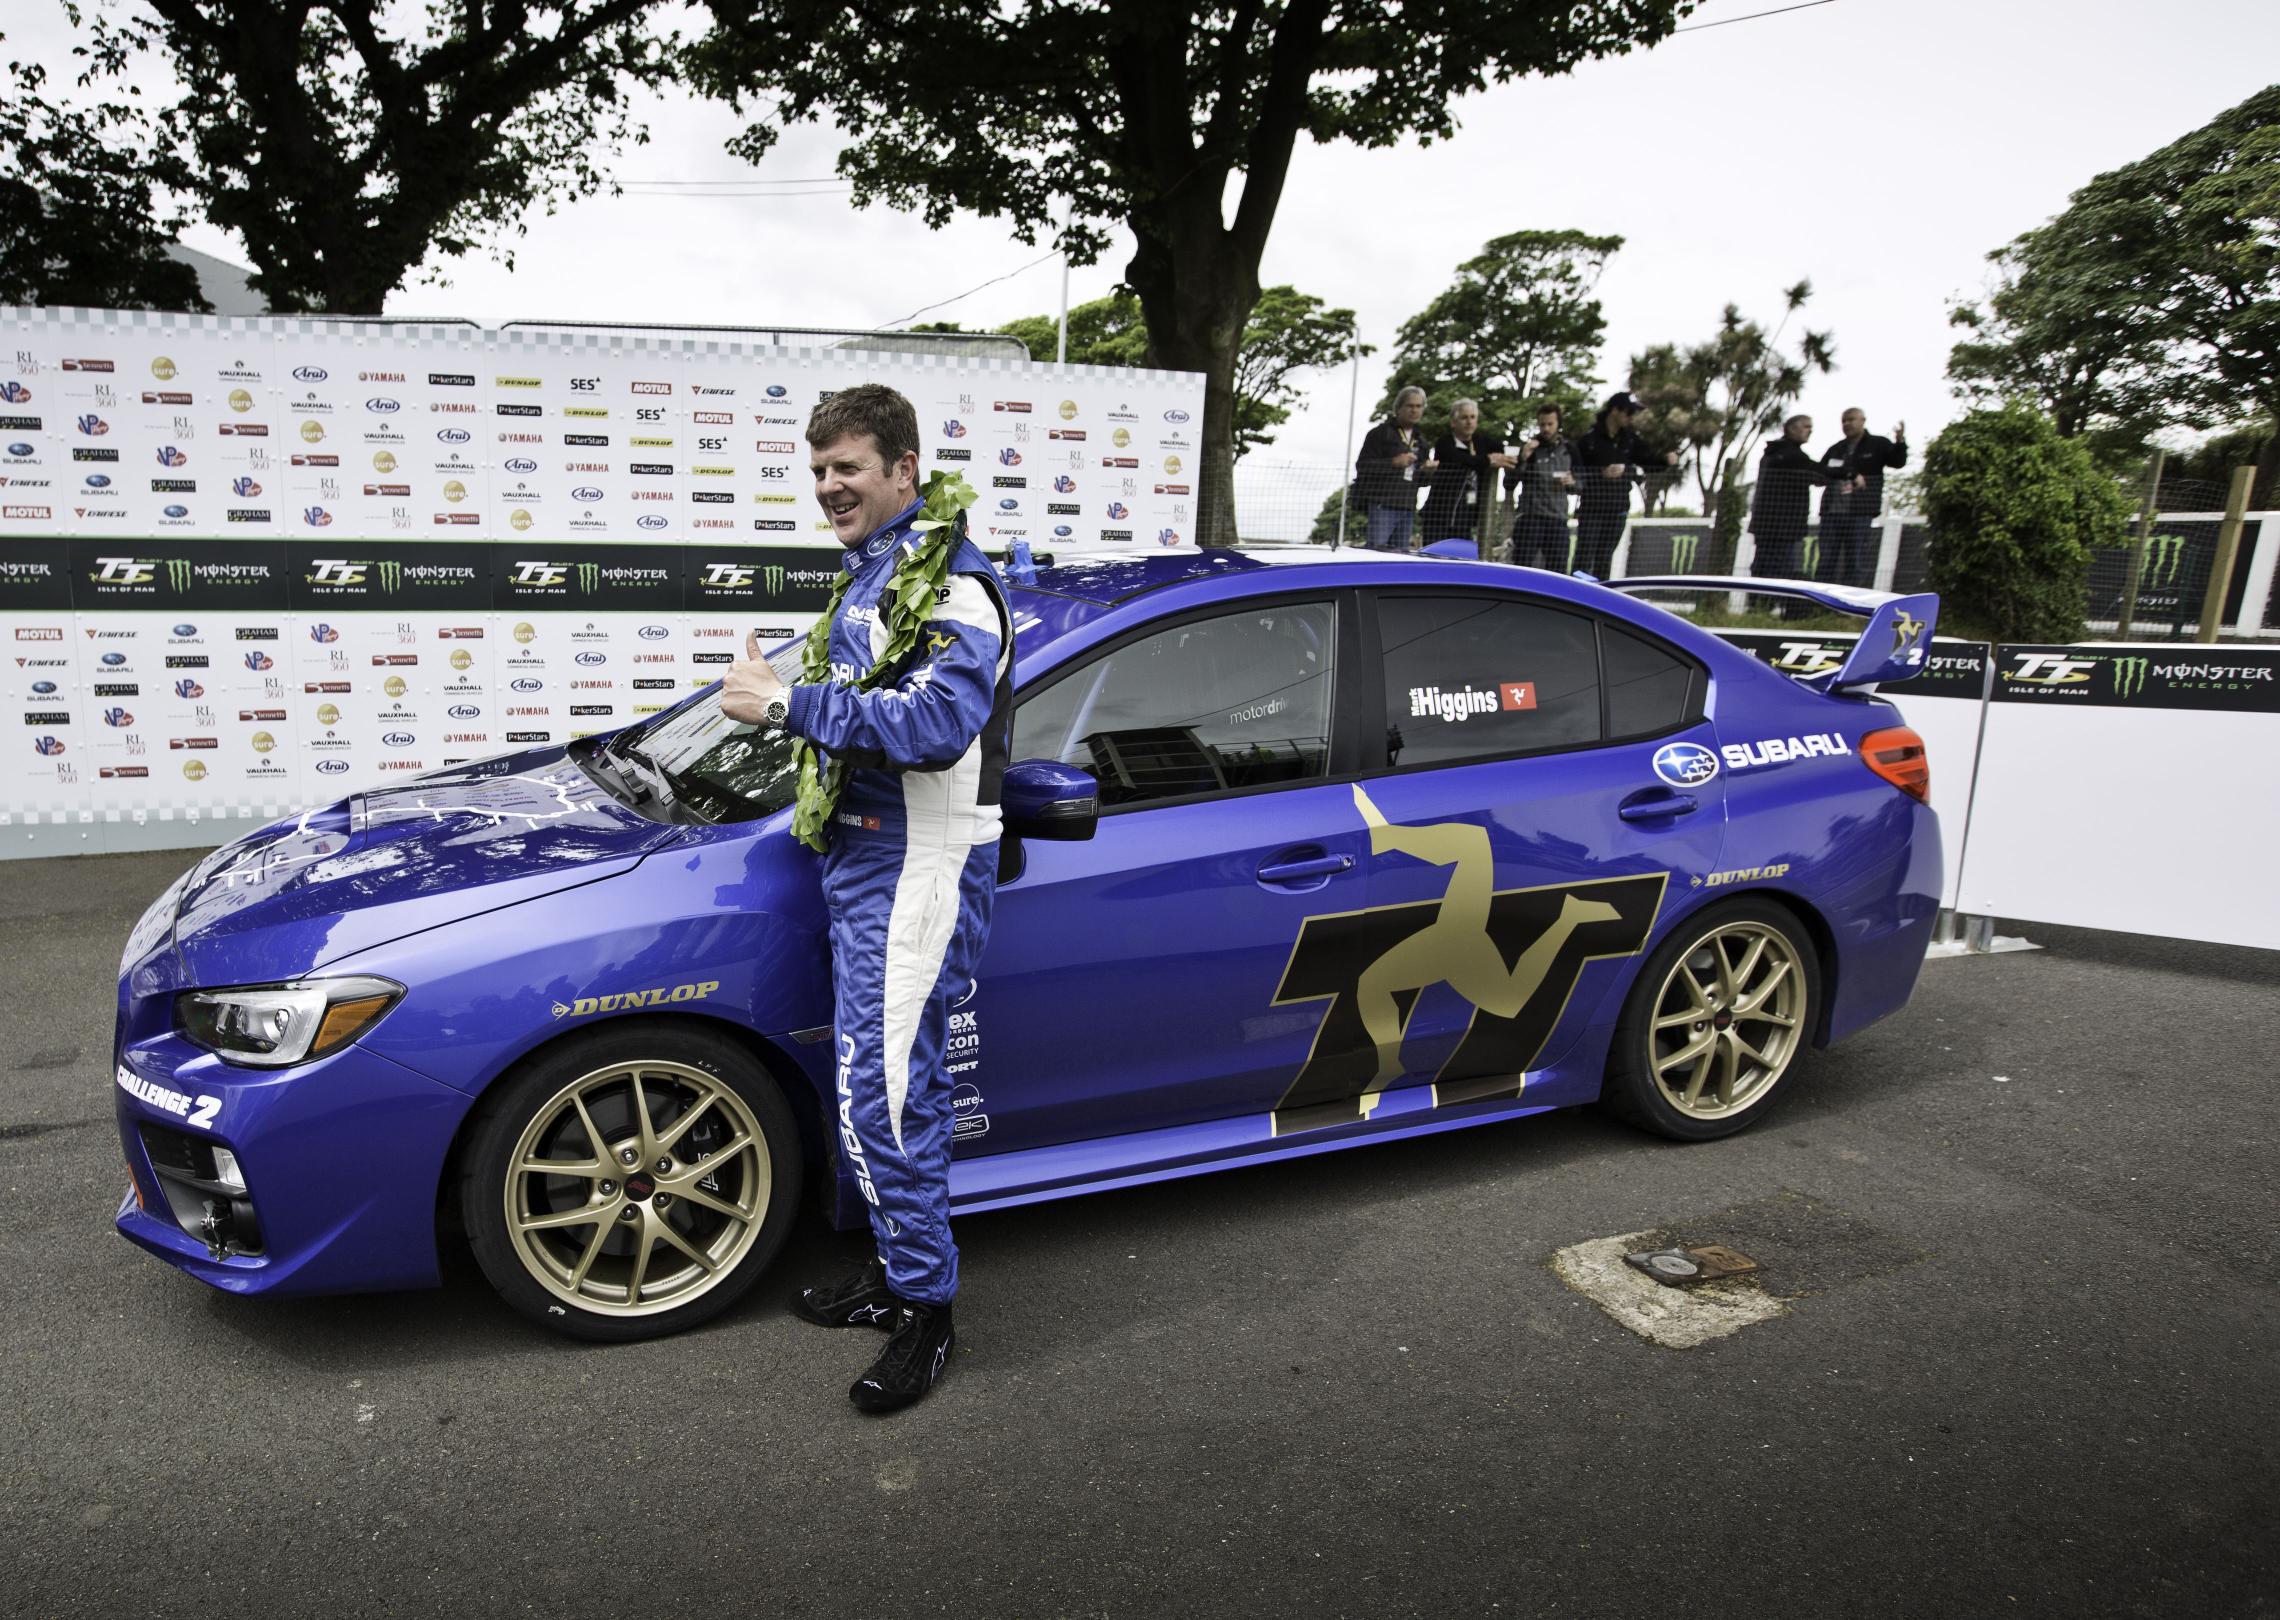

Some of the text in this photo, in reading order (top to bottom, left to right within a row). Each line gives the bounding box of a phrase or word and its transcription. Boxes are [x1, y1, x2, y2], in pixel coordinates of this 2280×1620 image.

[295, 366, 326, 379] Arai
[369, 374, 405, 382] YAMAHA
[571, 379, 594, 390] SES
[634, 384, 670, 393] MOTUL
[369, 399, 399, 411] Arai
[441, 404, 476, 412] YAMAHA
[637, 410, 660, 420] SES
[696, 414, 732, 422] MOTUL
[1166, 411, 1189, 420] Arai
[440, 430, 468, 440] Arai
[509, 434, 542, 442] YAMAHA
[699, 438, 721, 449] SES
[758, 443, 794, 451] MOTUL
[75, 449, 118, 458] GRAHAM
[508, 460, 535, 469] Arai
[576, 464, 608, 472] YAMAHA
[762, 468, 784, 478] SES
[153, 480, 195, 489] GRAHAM
[574, 489, 602, 498] Arai
[641, 492, 673, 500] YAMAHA
[6, 508, 48, 517] MOTUL
[228, 511, 270, 520] GRAHAM
[640, 517, 666, 526] Arai
[702, 520, 734, 528] YAMAHA
[0, 563, 51, 575] NSTER
[95, 558, 155, 584] TT
[194, 565, 270, 577] MONSTER
[310, 560, 367, 584] TT
[404, 566, 474, 578] MONSTER
[514, 562, 568, 586] TT
[602, 568, 667, 580] MONSTER
[706, 563, 756, 587] TT
[787, 571, 840, 583] MONSTE
[18, 630, 61, 639] MOTUL
[642, 628, 666, 636] Arai
[579, 654, 604, 662] Arai
[1781, 643, 1843, 671] TT
[1906, 648, 1924, 665] 2
[1926, 656, 1981, 672] STER
[2014, 654, 2096, 684] TT
[2152, 664, 2274, 681] MONSTER
[514, 680, 540, 689] Arai
[1410, 688, 1419, 716] Mark
[1419, 685, 1498, 722] Higgins
[451, 706, 479, 716] Arai
[386, 734, 414, 742] Arai
[1721, 733, 1847, 768] SUBARU
[320, 761, 347, 770] Arai
[1705, 864, 1789, 886] DUNLOP
[570, 980, 719, 1016] DUNLOP
[949, 1011, 976, 1029] ex
[948, 1034, 978, 1049] con
[946, 1048, 978, 1059] SECURITY
[945, 1061, 978, 1073] ORT
[116, 1065, 222, 1130] CHALLENGE 2
[839, 1034, 880, 1206] SUBARU
